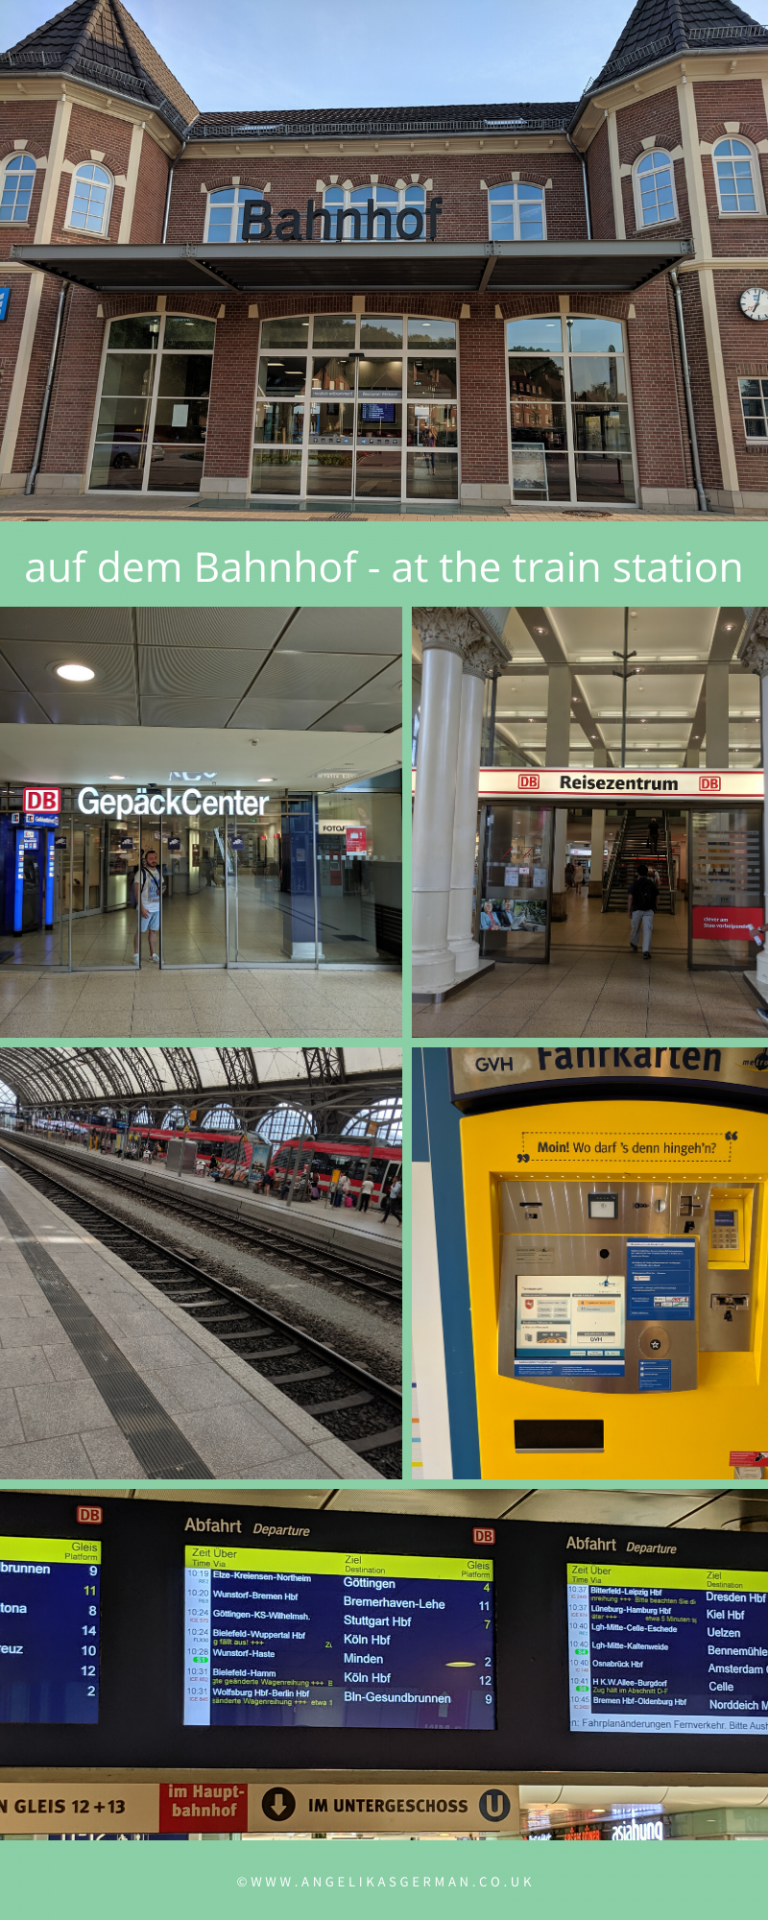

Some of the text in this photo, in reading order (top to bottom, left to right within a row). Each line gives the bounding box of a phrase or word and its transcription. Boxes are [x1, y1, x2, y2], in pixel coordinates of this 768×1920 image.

[242, 198, 442, 241] Bahnhof
[520, 775, 719, 791] DB Reisezentrum DB
[28, 791, 56, 809] DB
[77, 786, 269, 820] GepäckCenter
[476, 1056, 513, 1072] GVH
[538, 1141, 570, 1153] Moin!
[573, 1142, 591, 1153] Wo
[594, 1142, 617, 1153] darf
[632, 1142, 660, 1154] denn
[663, 1142, 717, 1156] hingeh'n?
[80, 1508, 100, 1521] DB
[184, 1518, 311, 1537] Abfahrt Departure
[475, 1530, 493, 1542] DB
[72, 1542, 98, 1552] Gleis
[566, 1536, 677, 1555] Abfahrt Departure
[64, 1552, 98, 1562] Platform
[192, 1546, 237, 1559] Zeit Über
[213, 1560, 226, 1568] Via
[345, 1556, 362, 1565] Ziel
[467, 1561, 490, 1571] Gleis
[0, 1562, 51, 1575] brunnen
[89, 1566, 98, 1576] 9
[345, 1566, 386, 1574] Destination
[572, 1565, 612, 1576] Zeit Über
[213, 1571, 312, 1583] Elze-Kreiensen-Northeim
[572, 1576, 588, 1584] Time
[707, 1571, 722, 1580] Ziel
[343, 1577, 396, 1591] Göttingen
[483, 1584, 491, 1592] 4
[707, 1581, 743, 1589] Destination
[84, 1586, 96, 1596] 11
[188, 1589, 209, 1597] 10:20
[213, 1590, 298, 1601] Wunstorf-Bremen Hbf
[591, 1587, 649, 1597] Bitterfeld-Leipzig
[344, 1596, 446, 1610] Bremerhaven-Lehe
[706, 1592, 766, 1603] Dresden Hbf
[0, 1603, 27, 1614] tona
[89, 1606, 97, 1616] 8
[479, 1602, 490, 1611] 11
[591, 1605, 658, 1615] Lüneburg-Hamburg
[707, 1610, 745, 1620] Kiel Hbf
[344, 1615, 412, 1628] Stuttgart Hbf
[484, 1620, 491, 1629] 7
[570, 1622, 588, 1630] 10:40
[82, 1626, 97, 1636] 14
[213, 1629, 306, 1640] Bielefeld-Wuppertal Hbf
[707, 1627, 741, 1638] Uelzen
[344, 1634, 391, 1645] Köln Hbf
[82, 1646, 97, 1656] 10
[213, 1649, 276, 1658] Wunstorf-Haste
[708, 1645, 768, 1656] Bennemühle
[344, 1653, 384, 1664] Minden
[485, 1658, 492, 1667] 2
[81, 1666, 96, 1676] 12
[213, 1668, 277, 1678] Bielefeld-Hamm
[708, 1663, 764, 1674] Amsterdam
[344, 1672, 391, 1683] Köln Hbf
[479, 1676, 492, 1686] 12
[88, 1686, 96, 1696] 2
[709, 1681, 734, 1692] Celle
[213, 1688, 310, 1698] Wolfsburg Hbf-Berlin Hbf
[344, 1692, 452, 1704] Bln-Gesundbrunnen
[486, 1695, 492, 1704] 9
[593, 1696, 687, 1707] Bremen Hbf-Oldenburg Hbf
[710, 1700, 759, 1711] Norddeich
[582, 1718, 748, 1730] Fahrplanänderungen Fernverkehr. Bitte
[168, 1784, 245, 1801] im Haupt-
[14, 1799, 66, 1814] GLEIS
[172, 1803, 238, 1817] bahnhof
[308, 1799, 468, 1813] IM UNTERGESCHOSS
[486, 1794, 504, 1817] U
